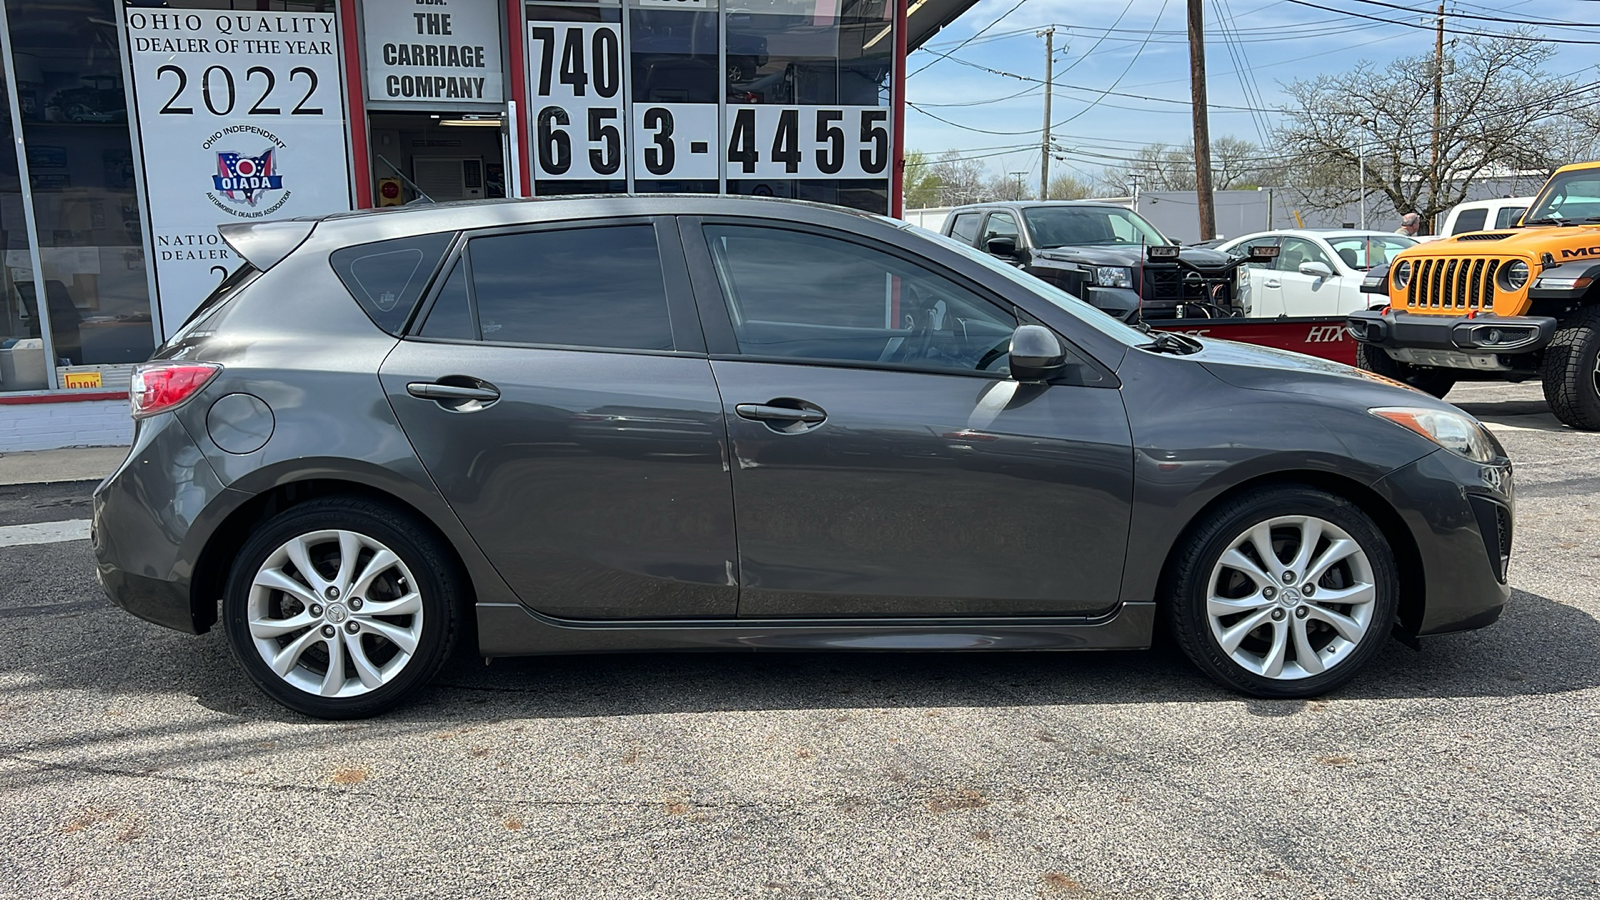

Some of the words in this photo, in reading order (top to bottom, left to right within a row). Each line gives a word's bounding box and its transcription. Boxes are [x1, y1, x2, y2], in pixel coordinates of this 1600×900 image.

[130, 13, 202, 31] OHIO
[216, 15, 333, 35] QUALITY
[413, 13, 452, 36] THE
[135, 37, 211, 53] DEALER
[215, 39, 239, 54] OF
[243, 41, 281, 54] THE
[285, 41, 333, 55] YEAR
[383, 43, 485, 68] CARRIAGE
[532, 26, 620, 98] 740
[157, 65, 323, 116] 2022
[386, 75, 485, 98] COMPANY
[202, 131, 223, 150] OHIO
[223, 125, 287, 149] INDEPENDENT
[221, 177, 271, 190] OIADA
[206, 191, 237, 216] AUTOMOBILE
[263, 190, 291, 214] ASSOCIATION
[161, 249, 229, 261] DEALER
[1305, 326, 1347, 343] HTX
